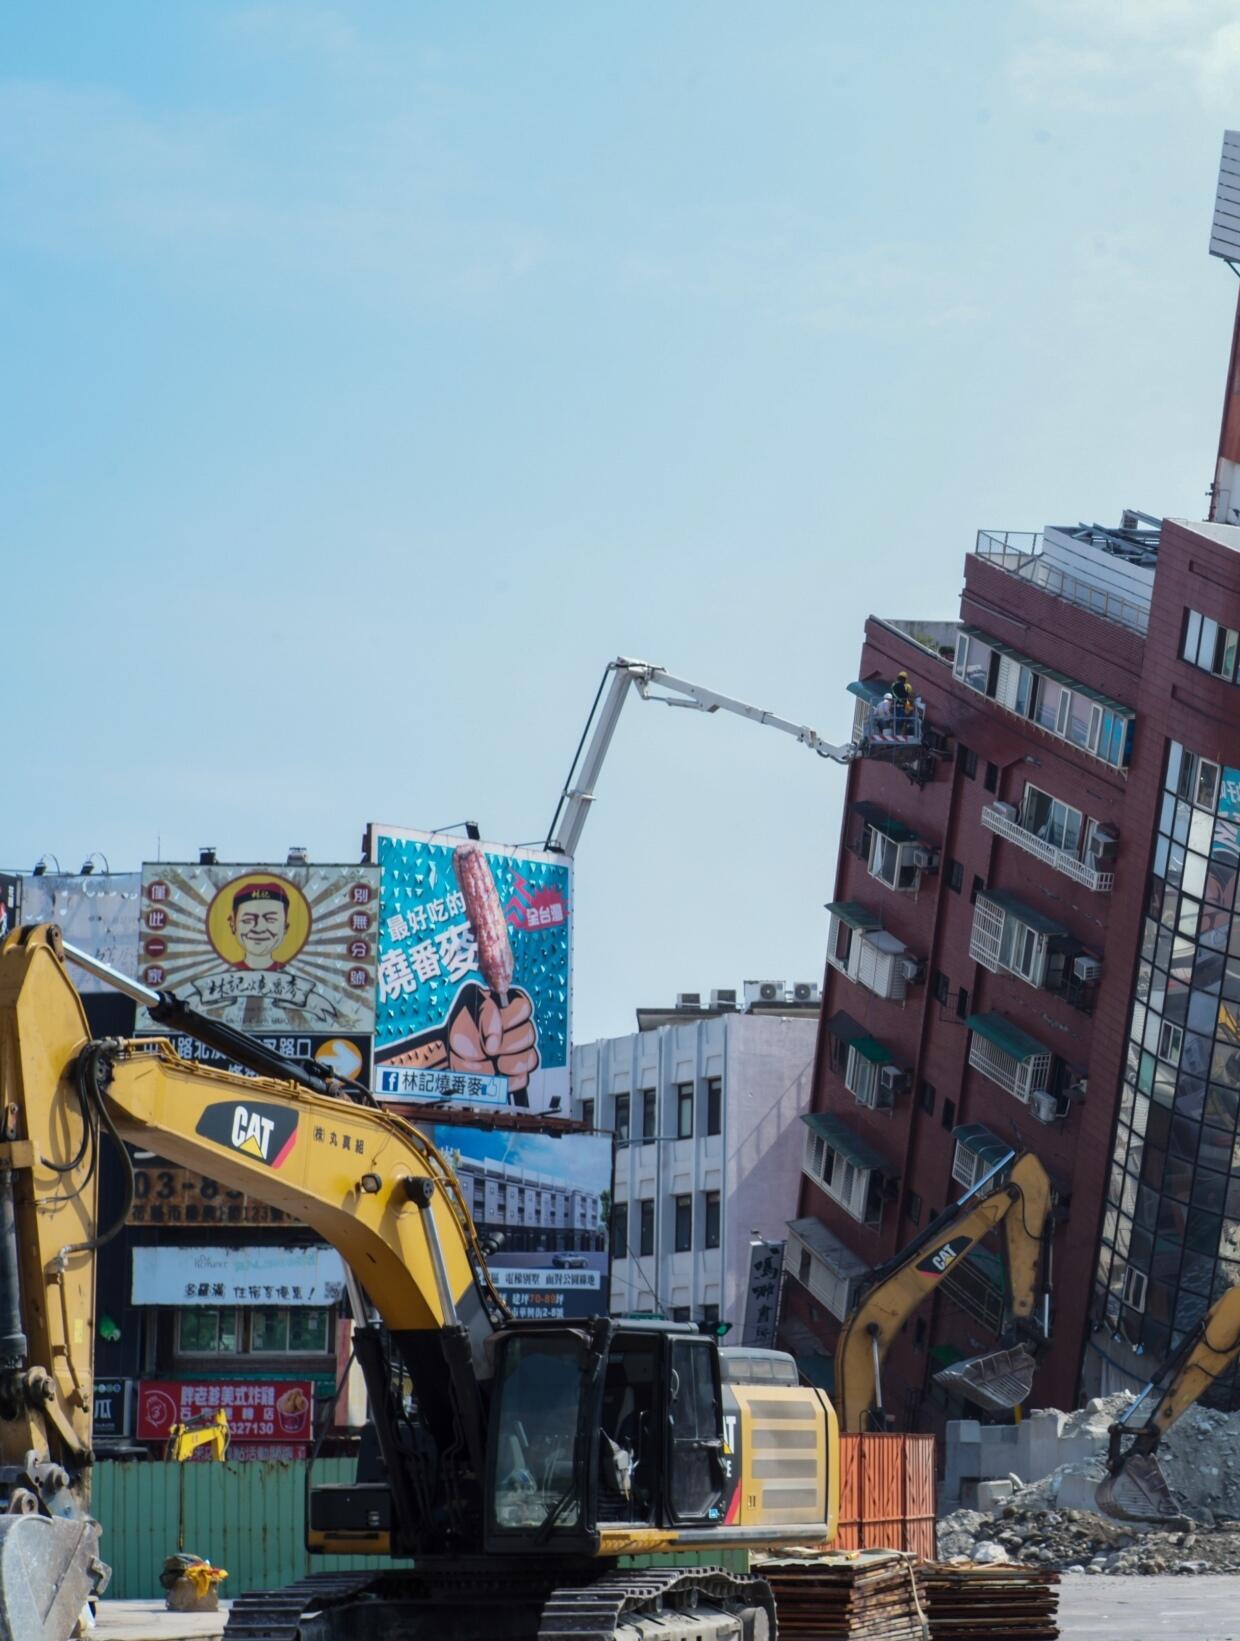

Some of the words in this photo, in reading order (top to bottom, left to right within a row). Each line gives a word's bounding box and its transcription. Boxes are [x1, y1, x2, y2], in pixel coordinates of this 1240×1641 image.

[147, 884, 167, 984] 僅此一家
[350, 888, 369, 985] 別無分號
[386, 891, 467, 942] 最好吃的
[378, 920, 480, 1004] 燒番麥
[402, 1071, 483, 1097] 林記燒番麥
[231, 1105, 275, 1160] CAT
[932, 1243, 958, 1271] CAT
